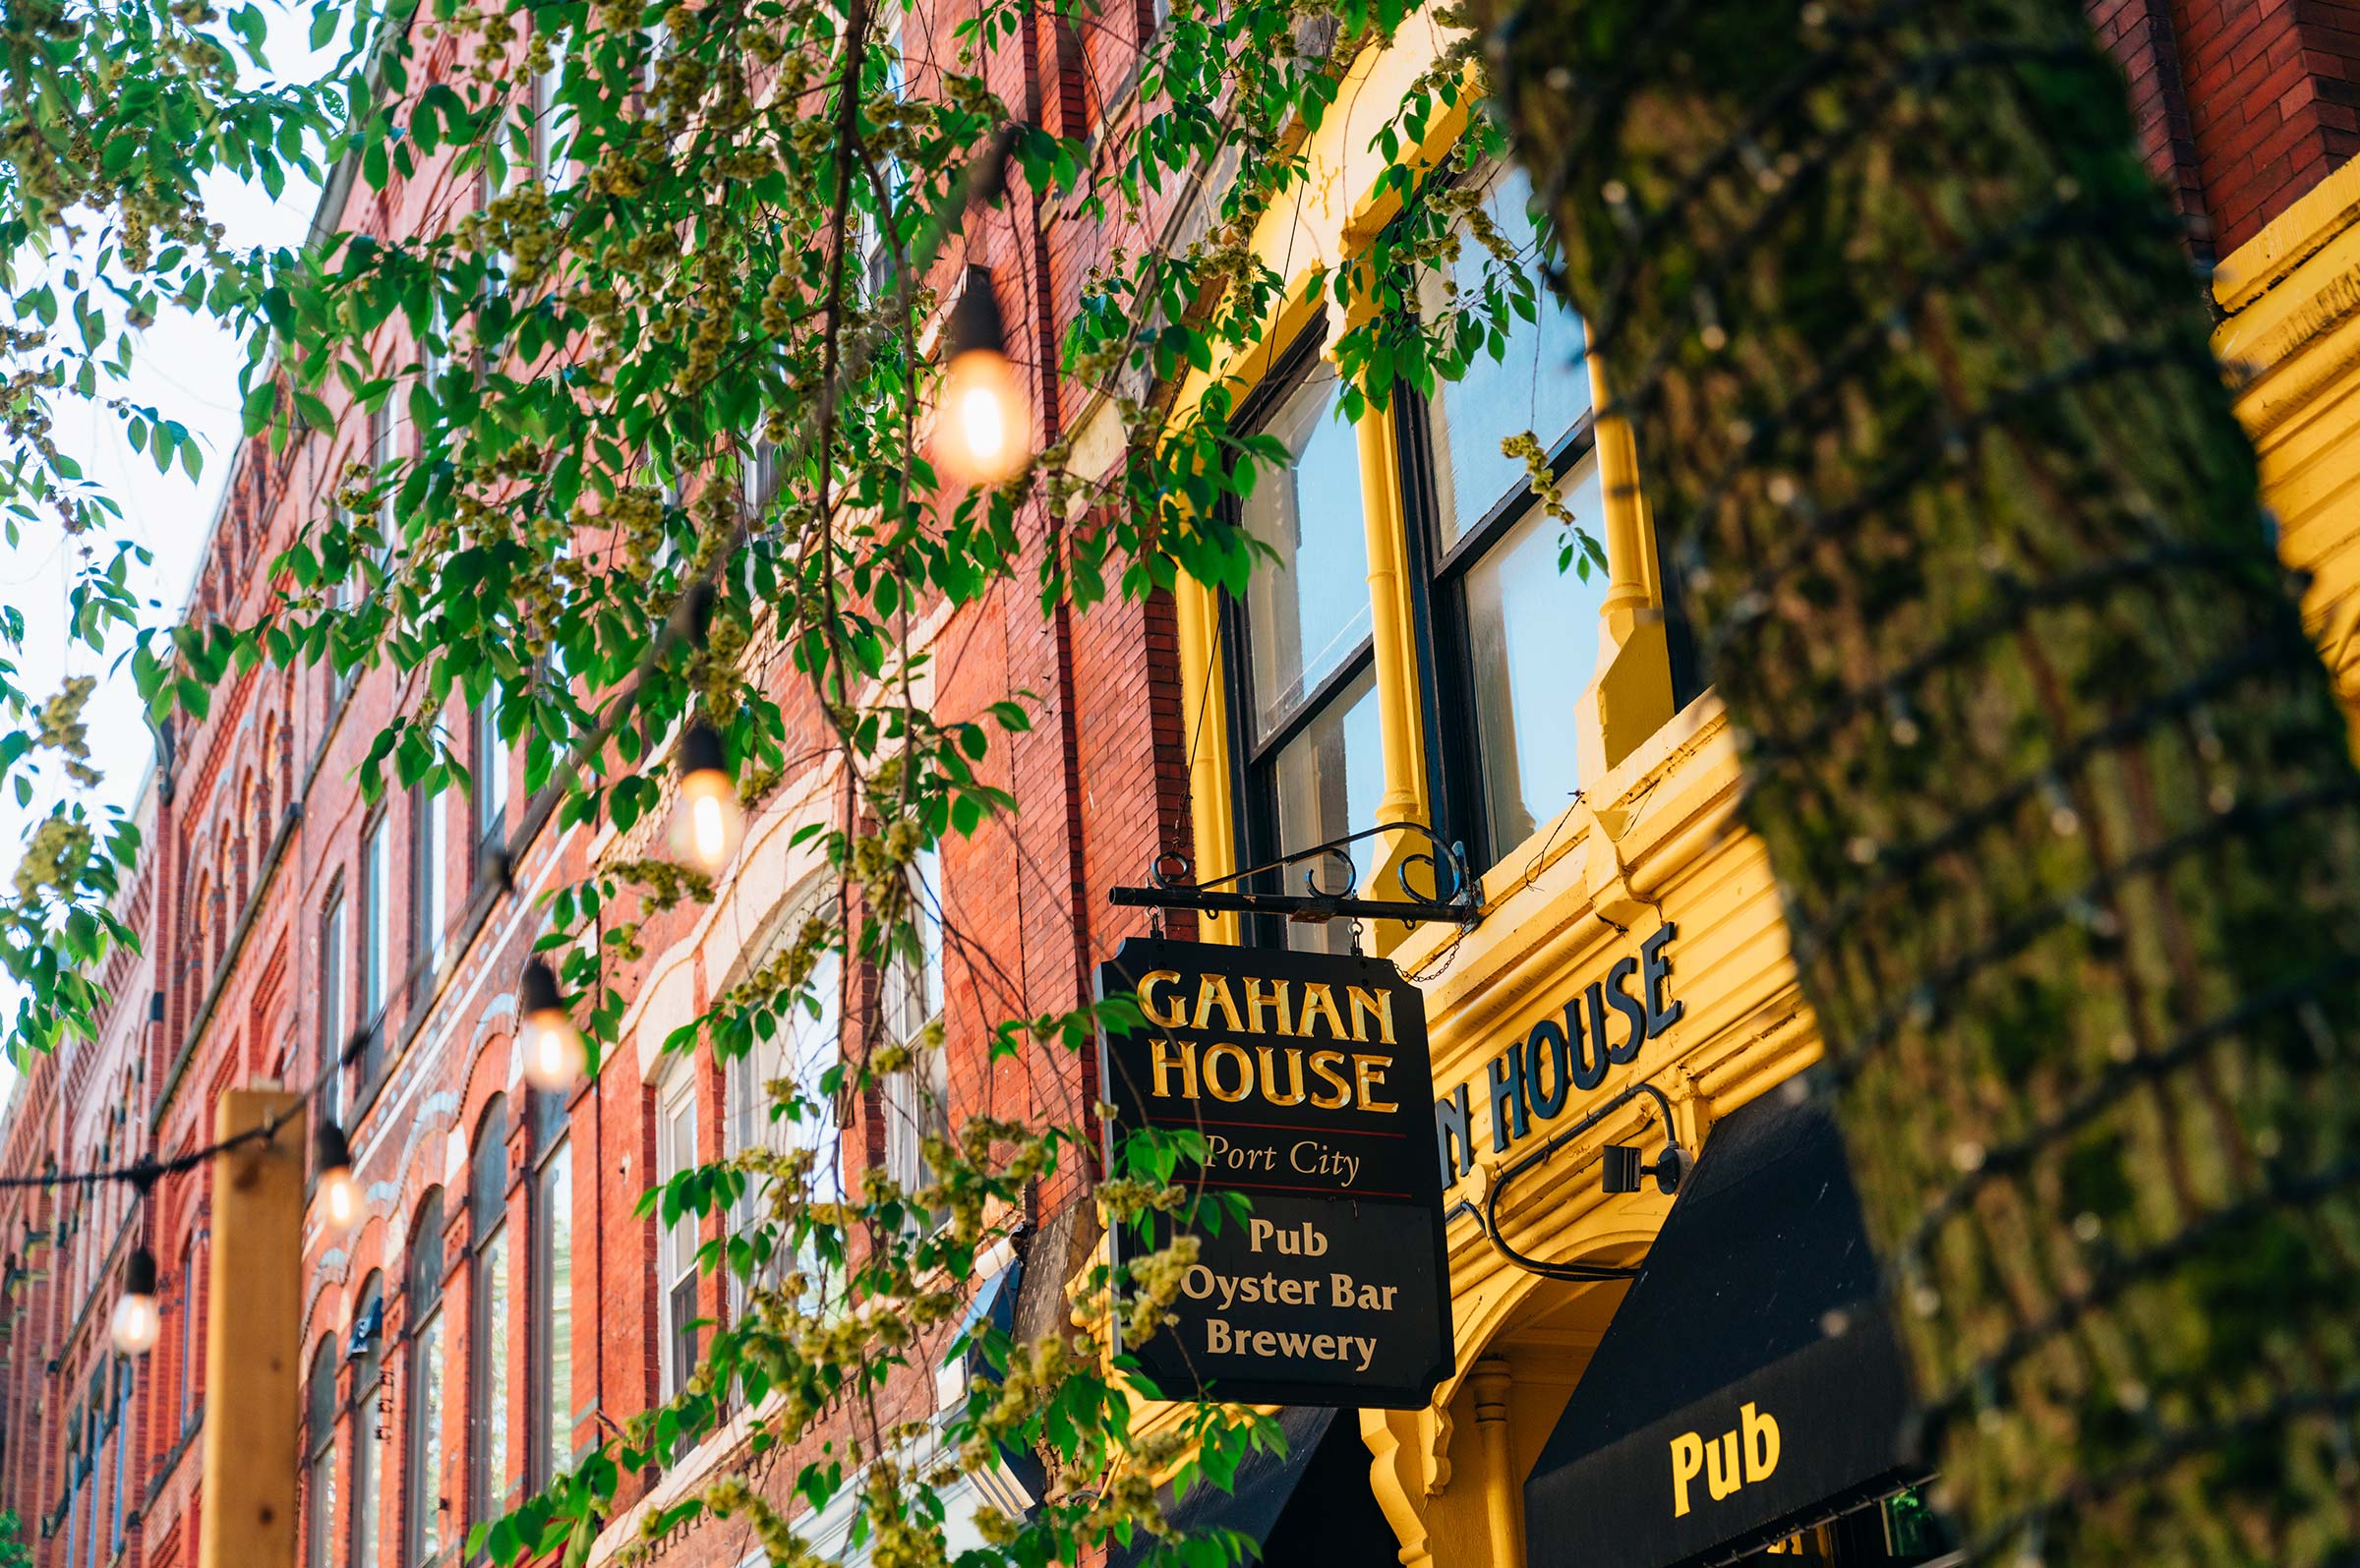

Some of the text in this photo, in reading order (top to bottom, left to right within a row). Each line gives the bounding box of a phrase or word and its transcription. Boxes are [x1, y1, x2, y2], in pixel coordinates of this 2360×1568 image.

[1137, 969, 1397, 1045] GAHAN
[1487, 922, 1682, 1154] HOUSE
[1149, 1038, 1399, 1114] HOUSE
[1203, 1134, 1360, 1188] Port City
[1249, 1218, 1329, 1257] Pub
[1180, 1264, 1398, 1311] Oyster Bar
[1206, 1318, 1378, 1372] Brewery
[1670, 1401, 1781, 1519] Pub
